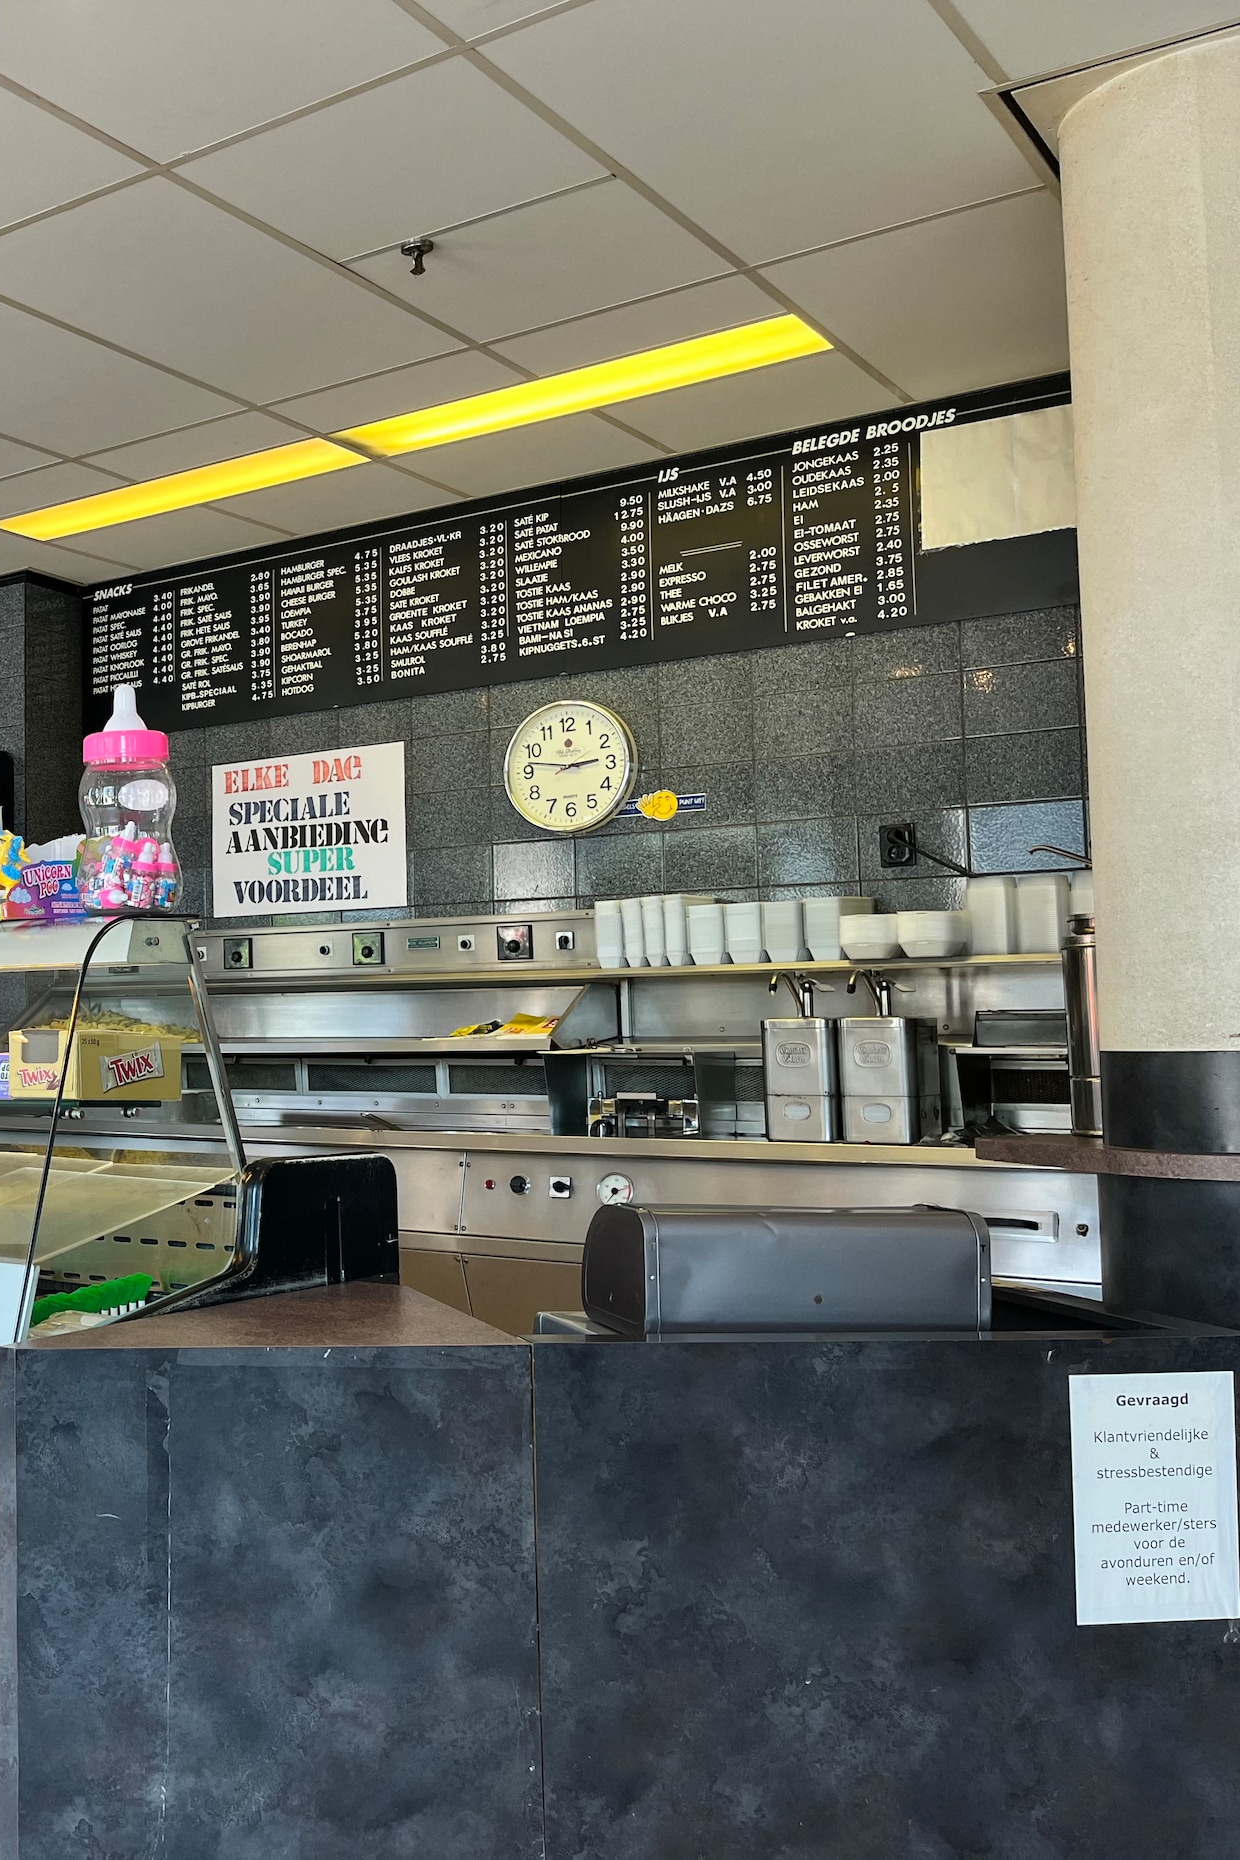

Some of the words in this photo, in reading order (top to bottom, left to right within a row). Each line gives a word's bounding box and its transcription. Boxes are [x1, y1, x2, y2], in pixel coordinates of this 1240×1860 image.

[792, 428, 860, 455] BELEGDE
[866, 408, 956, 440] BROODJES
[792, 451, 859, 473] JONGEKAAS
[873, 443, 899, 457] 2.25
[658, 468, 679, 482] IJS
[792, 466, 852, 485] OUDEKAAS
[873, 457, 899, 470] 2.35
[658, 481, 710, 499] MILKSHAKE
[746, 469, 772, 481] 4.50
[793, 477, 865, 498] LEIDSEKAAS
[873, 470, 900, 483] 2.00
[658, 492, 712, 511] SLUSH-IJS
[747, 481, 772, 494] 3.00
[747, 494, 772, 506] 6.75
[793, 500, 819, 512] HAM
[794, 515, 804, 525] EI
[874, 498, 899, 509] 2.35
[795, 519, 856, 538] EI-TOMAAT
[875, 512, 900, 524] 2.75
[515, 546, 562, 563] MEXICANO
[621, 533, 644, 544] 4.00
[794, 533, 859, 552] OSSEWORST
[876, 526, 900, 538] 2.75
[515, 559, 557, 574] WILLEMPIE
[621, 545, 644, 556] 3.50
[659, 562, 683, 575] MELK
[749, 547, 776, 560] 2.00
[794, 546, 860, 565] LEVERWORST
[876, 539, 902, 552] 2.40
[515, 573, 548, 587] SLAATJE
[621, 557, 645, 568] 3.30
[660, 571, 706, 587] EXPRESSO
[749, 560, 776, 572] 2.75
[795, 563, 842, 578] GEZOND
[876, 554, 903, 565] 3.75
[180, 583, 215, 596] FRIKANDEL
[250, 572, 270, 582] 2.80
[390, 587, 415, 598] DOBBE
[480, 570, 504, 581] 3.20
[660, 588, 682, 600] THEE
[750, 573, 776, 586] 2.75
[796, 579, 828, 592] FILET
[830, 574, 868, 588] AMER.
[877, 567, 904, 579] 2.85
[93, 605, 109, 614] PATAT
[153, 592, 172, 602] 3.40
[94, 584, 132, 601] SNACKS
[661, 599, 696, 612] WARME
[699, 592, 737, 607] CHOCO
[750, 586, 777, 598] 3.25
[795, 588, 850, 604] GEBAKKEN
[854, 586, 863, 595] EI
[877, 580, 904, 592] 1.65
[281, 607, 312, 619] LOEMPIA
[356, 596, 377, 606] 5.35
[661, 612, 694, 625] BLIKJES
[750, 600, 776, 611] 2.75
[796, 600, 856, 617] BALGEHAKT
[878, 593, 906, 605] 3.00
[796, 617, 836, 630] KROKET
[877, 607, 907, 619] 4.20
[391, 666, 425, 679] BONITA
[481, 652, 506, 663] 2.75
[282, 684, 314, 696] HOTDOG
[357, 674, 380, 685] 3.50
[541, 726, 552, 741] 11
[559, 717, 576, 733] 12
[586, 720, 592, 735] 1
[526, 743, 541, 758] 10
[599, 734, 610, 748] 2
[524, 765, 534, 779] 9
[605, 755, 616, 769] 3
[224, 764, 289, 794] ELKE
[312, 755, 362, 784] DAG
[600, 777, 612, 791] 4
[529, 785, 541, 800] 8
[587, 794, 597, 808] 5
[229, 792, 350, 826] SPECIALE
[546, 799, 557, 813] 7
[565, 802, 577, 817] 6
[226, 819, 389, 854] AANBIEDING
[268, 847, 355, 875] SUPER
[40, 880, 59, 899] POO
[234, 876, 368, 903] VOORDEEL
[1116, 1393, 1189, 1407] Gevraagd
[1094, 1429, 1209, 1443] Klantvriendelijke
[1150, 1448, 1160, 1460] &
[1097, 1465, 1212, 1479] stressbestendige
[1125, 1502, 1188, 1514] Part-time
[1092, 1518, 1217, 1533] medewerker/sters
[1134, 1539, 1163, 1550] voor
[1169, 1537, 1186, 1548] de
[1101, 1555, 1173, 1568] avonduren
[1179, 1553, 1215, 1567] en/of
[1126, 1572, 1191, 1586] weekend.
